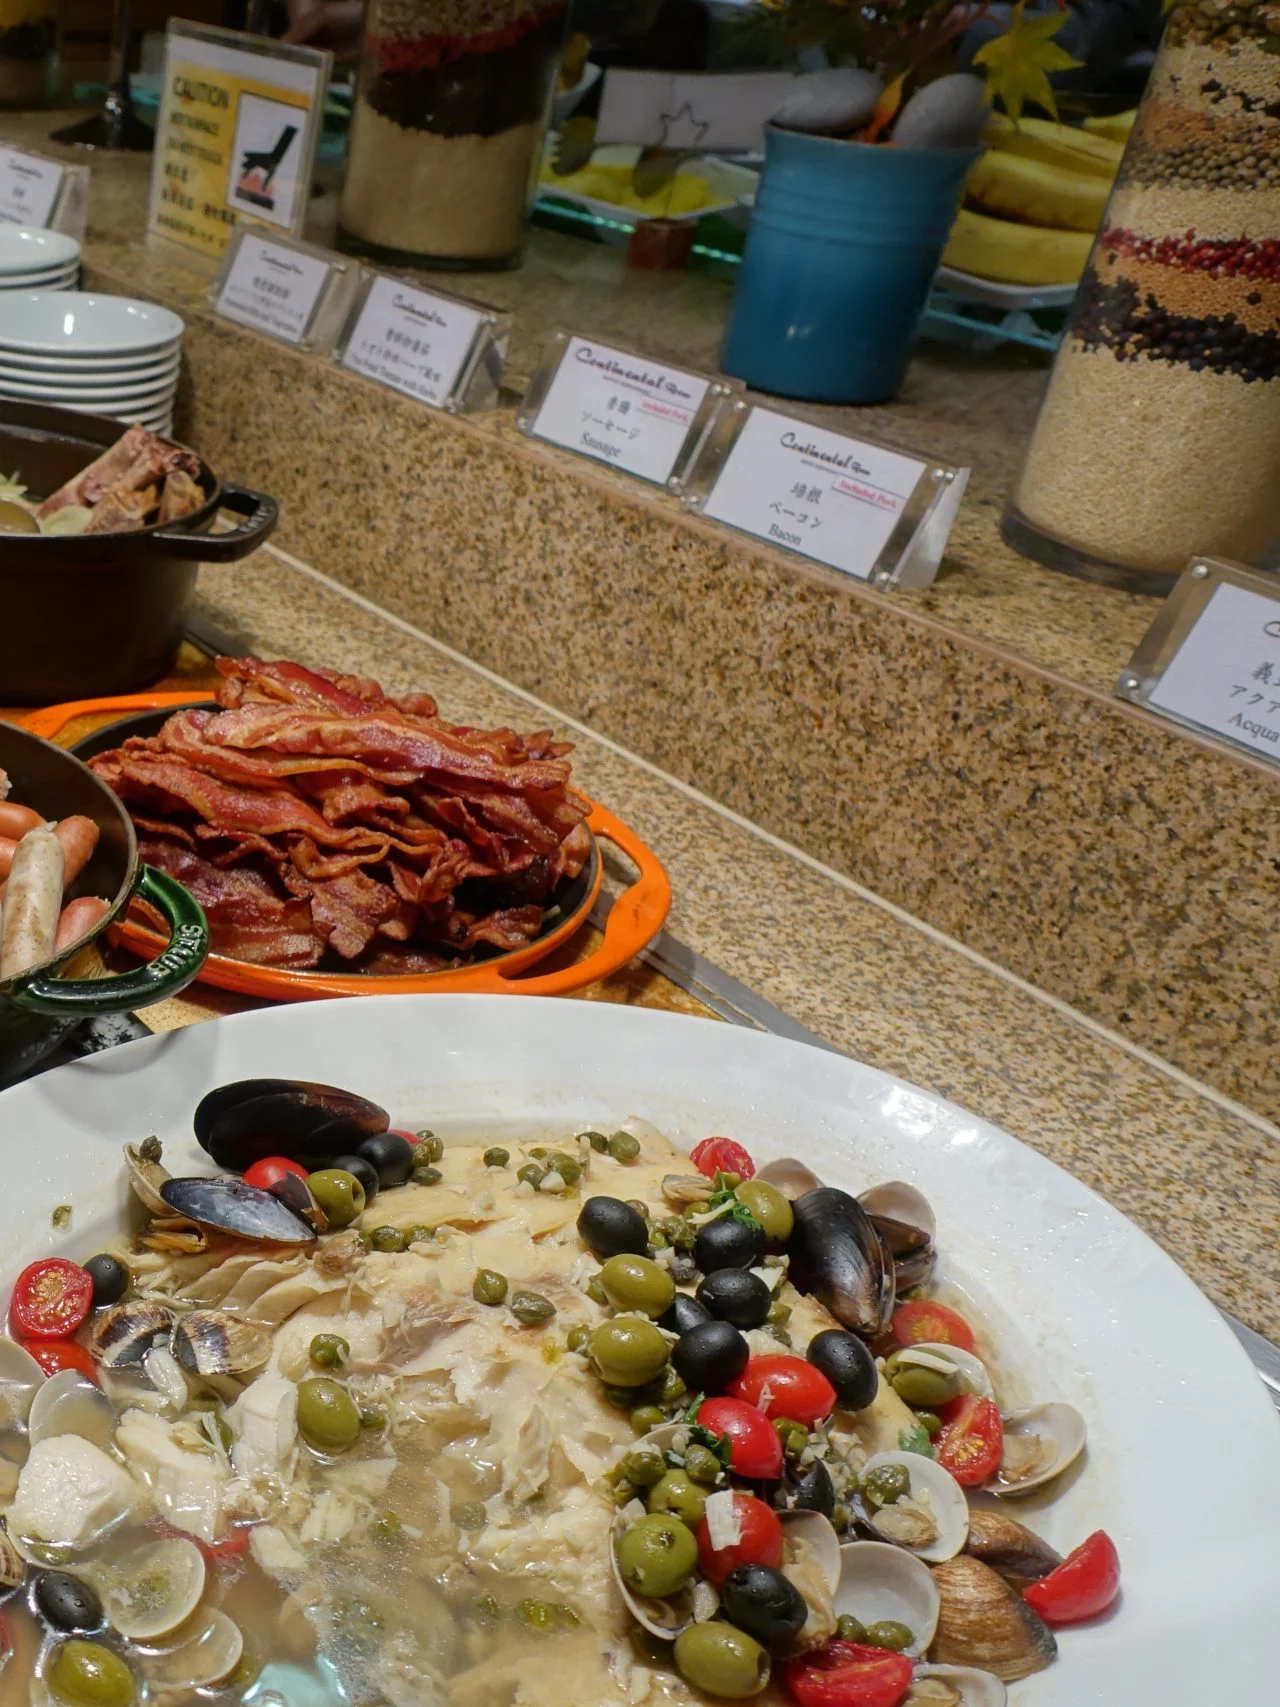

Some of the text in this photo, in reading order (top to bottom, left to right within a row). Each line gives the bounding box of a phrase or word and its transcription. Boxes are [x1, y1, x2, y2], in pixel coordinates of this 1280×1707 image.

[575, 347, 666, 389] Continental
[580, 431, 622, 458] Sausage
[780, 431, 853, 469] Continental
[769, 501, 823, 529] ベーコン
[768, 523, 802, 547] Bacon
[1228, 711, 1280, 743] Acqua
